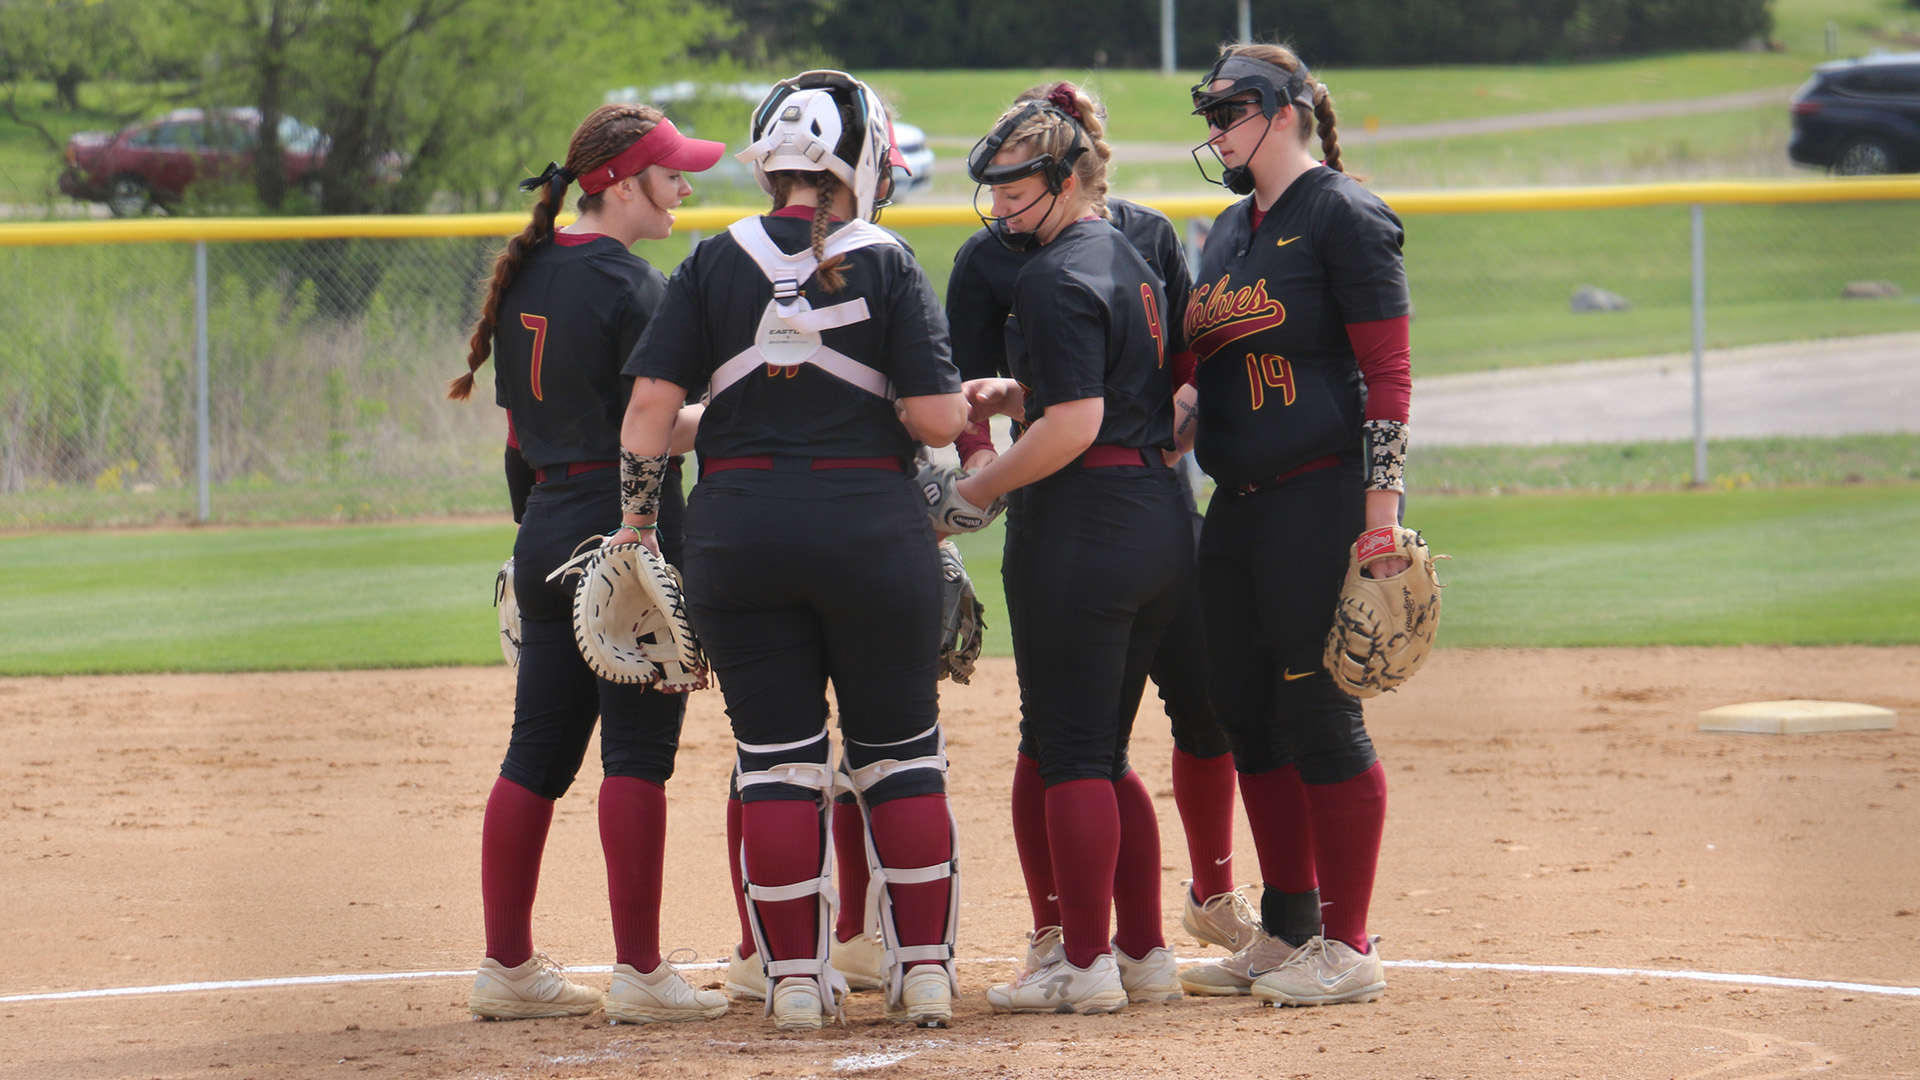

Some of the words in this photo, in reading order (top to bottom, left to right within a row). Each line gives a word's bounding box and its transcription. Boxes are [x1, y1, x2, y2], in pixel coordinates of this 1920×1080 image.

[1140, 282, 1164, 369] 9
[1183, 274, 1270, 343] Wolves
[520, 312, 547, 401] 7
[1246, 353, 1296, 411] 19
[1402, 585, 1415, 632] Rawlings
